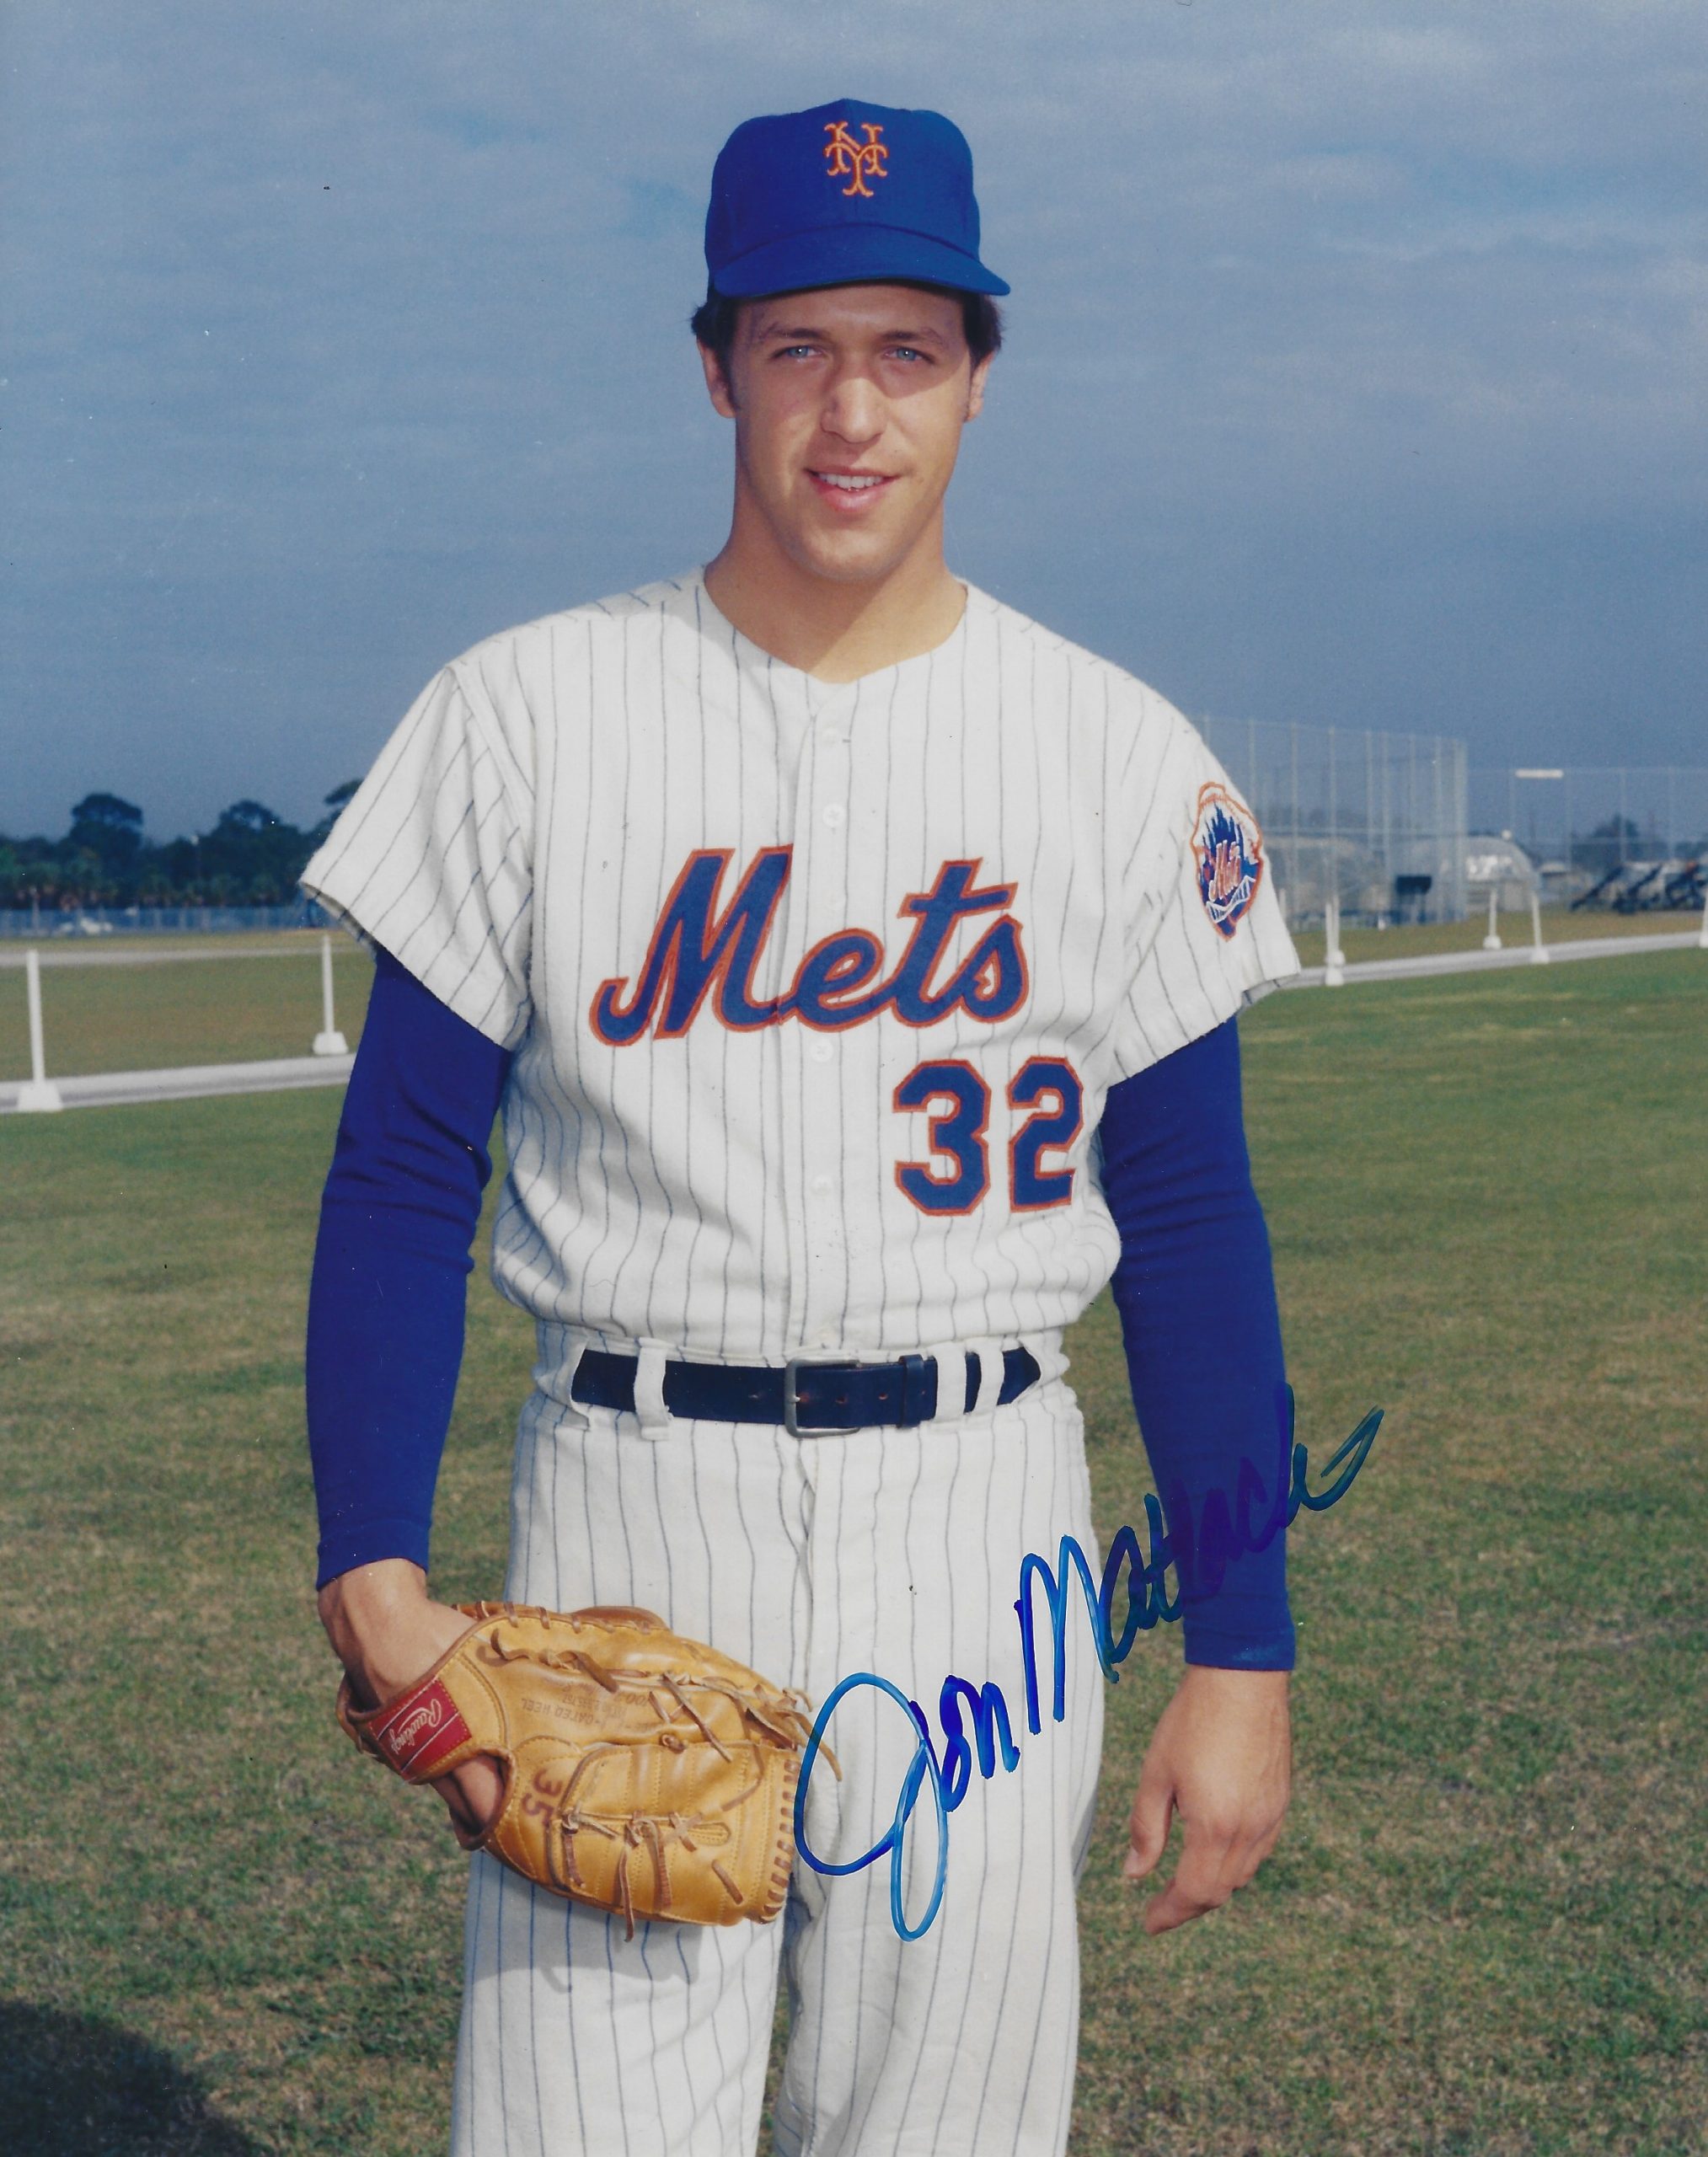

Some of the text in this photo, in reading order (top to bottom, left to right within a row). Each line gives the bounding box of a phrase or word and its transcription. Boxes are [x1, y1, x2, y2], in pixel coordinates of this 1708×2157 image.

[823, 120, 888, 198] NY
[589, 843, 1029, 1047] Mets
[892, 1055, 1084, 1217] 32
[389, 1698, 442, 1755] Rawlings
[793, 1671, 1020, 1942] Jon
